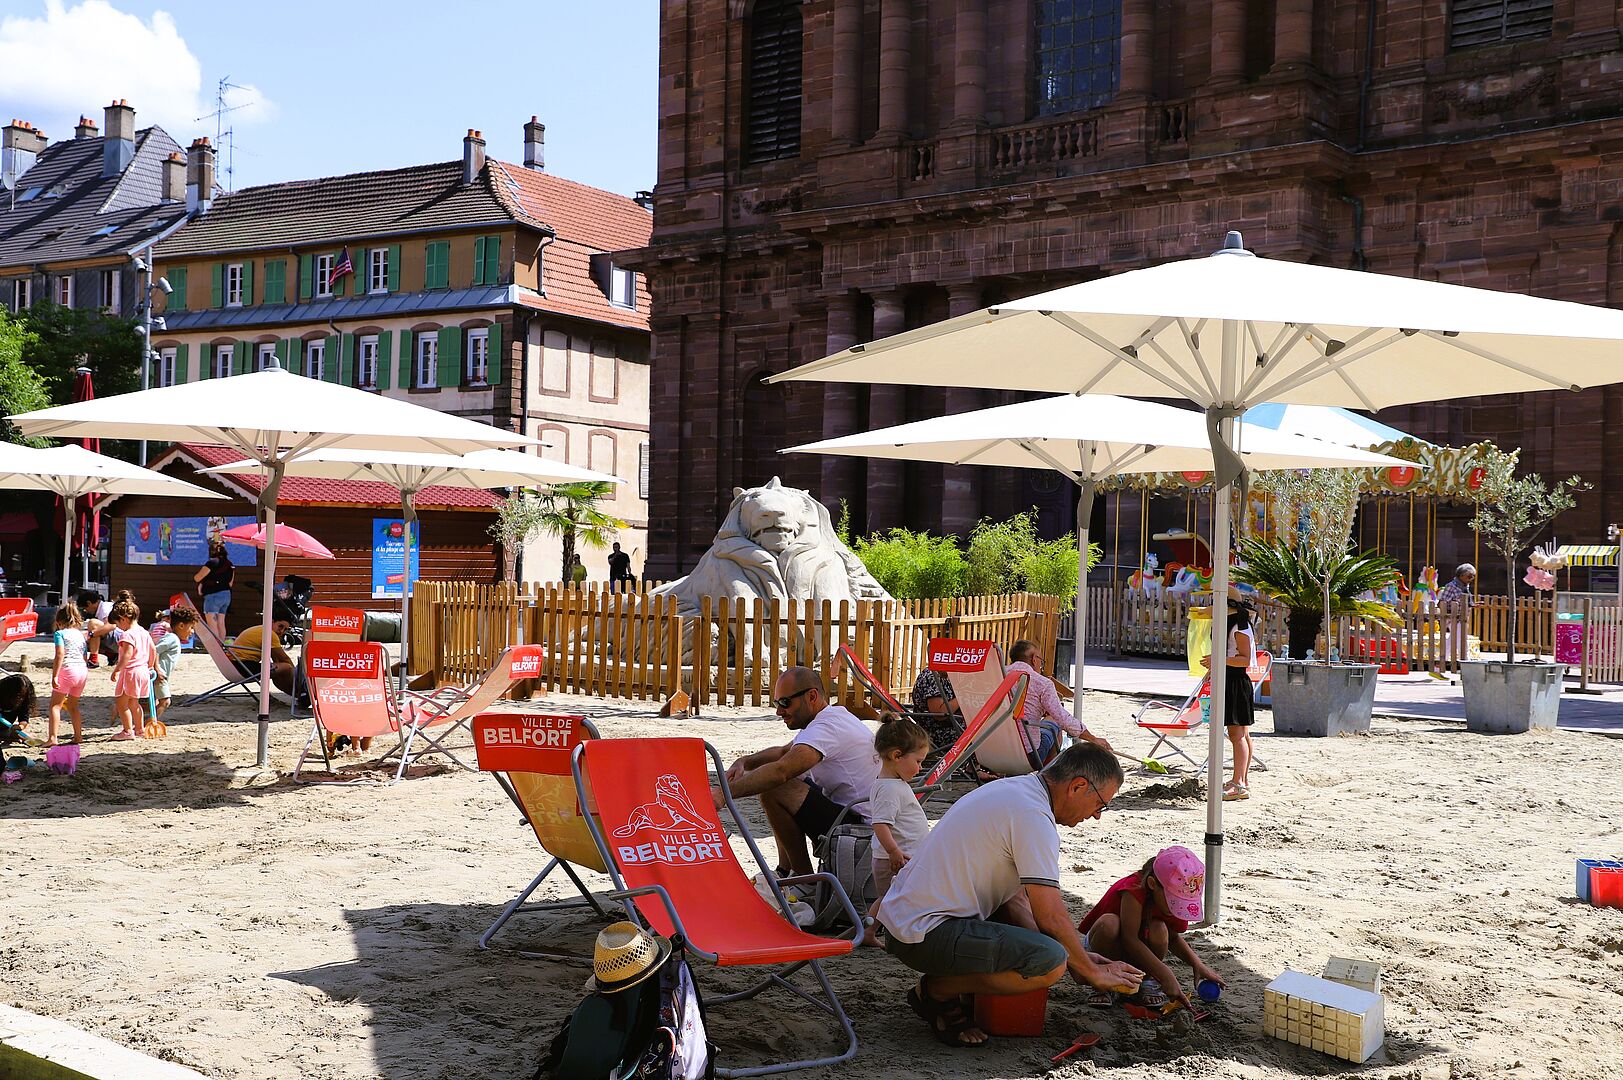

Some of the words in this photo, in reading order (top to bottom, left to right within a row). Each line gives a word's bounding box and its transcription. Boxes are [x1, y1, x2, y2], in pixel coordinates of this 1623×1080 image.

[315, 619, 359, 628] BELFORT
[312, 658, 374, 669] BELFORT
[933, 652, 984, 664] BELFORT
[511, 661, 538, 671] BELFORT
[521, 718, 553, 728] VILLE
[557, 718, 573, 729] DE
[483, 728, 572, 747] BELFORT
[660, 833, 698, 845] VILLE
[703, 832, 721, 842] DE
[618, 842, 724, 863] BELFORT
